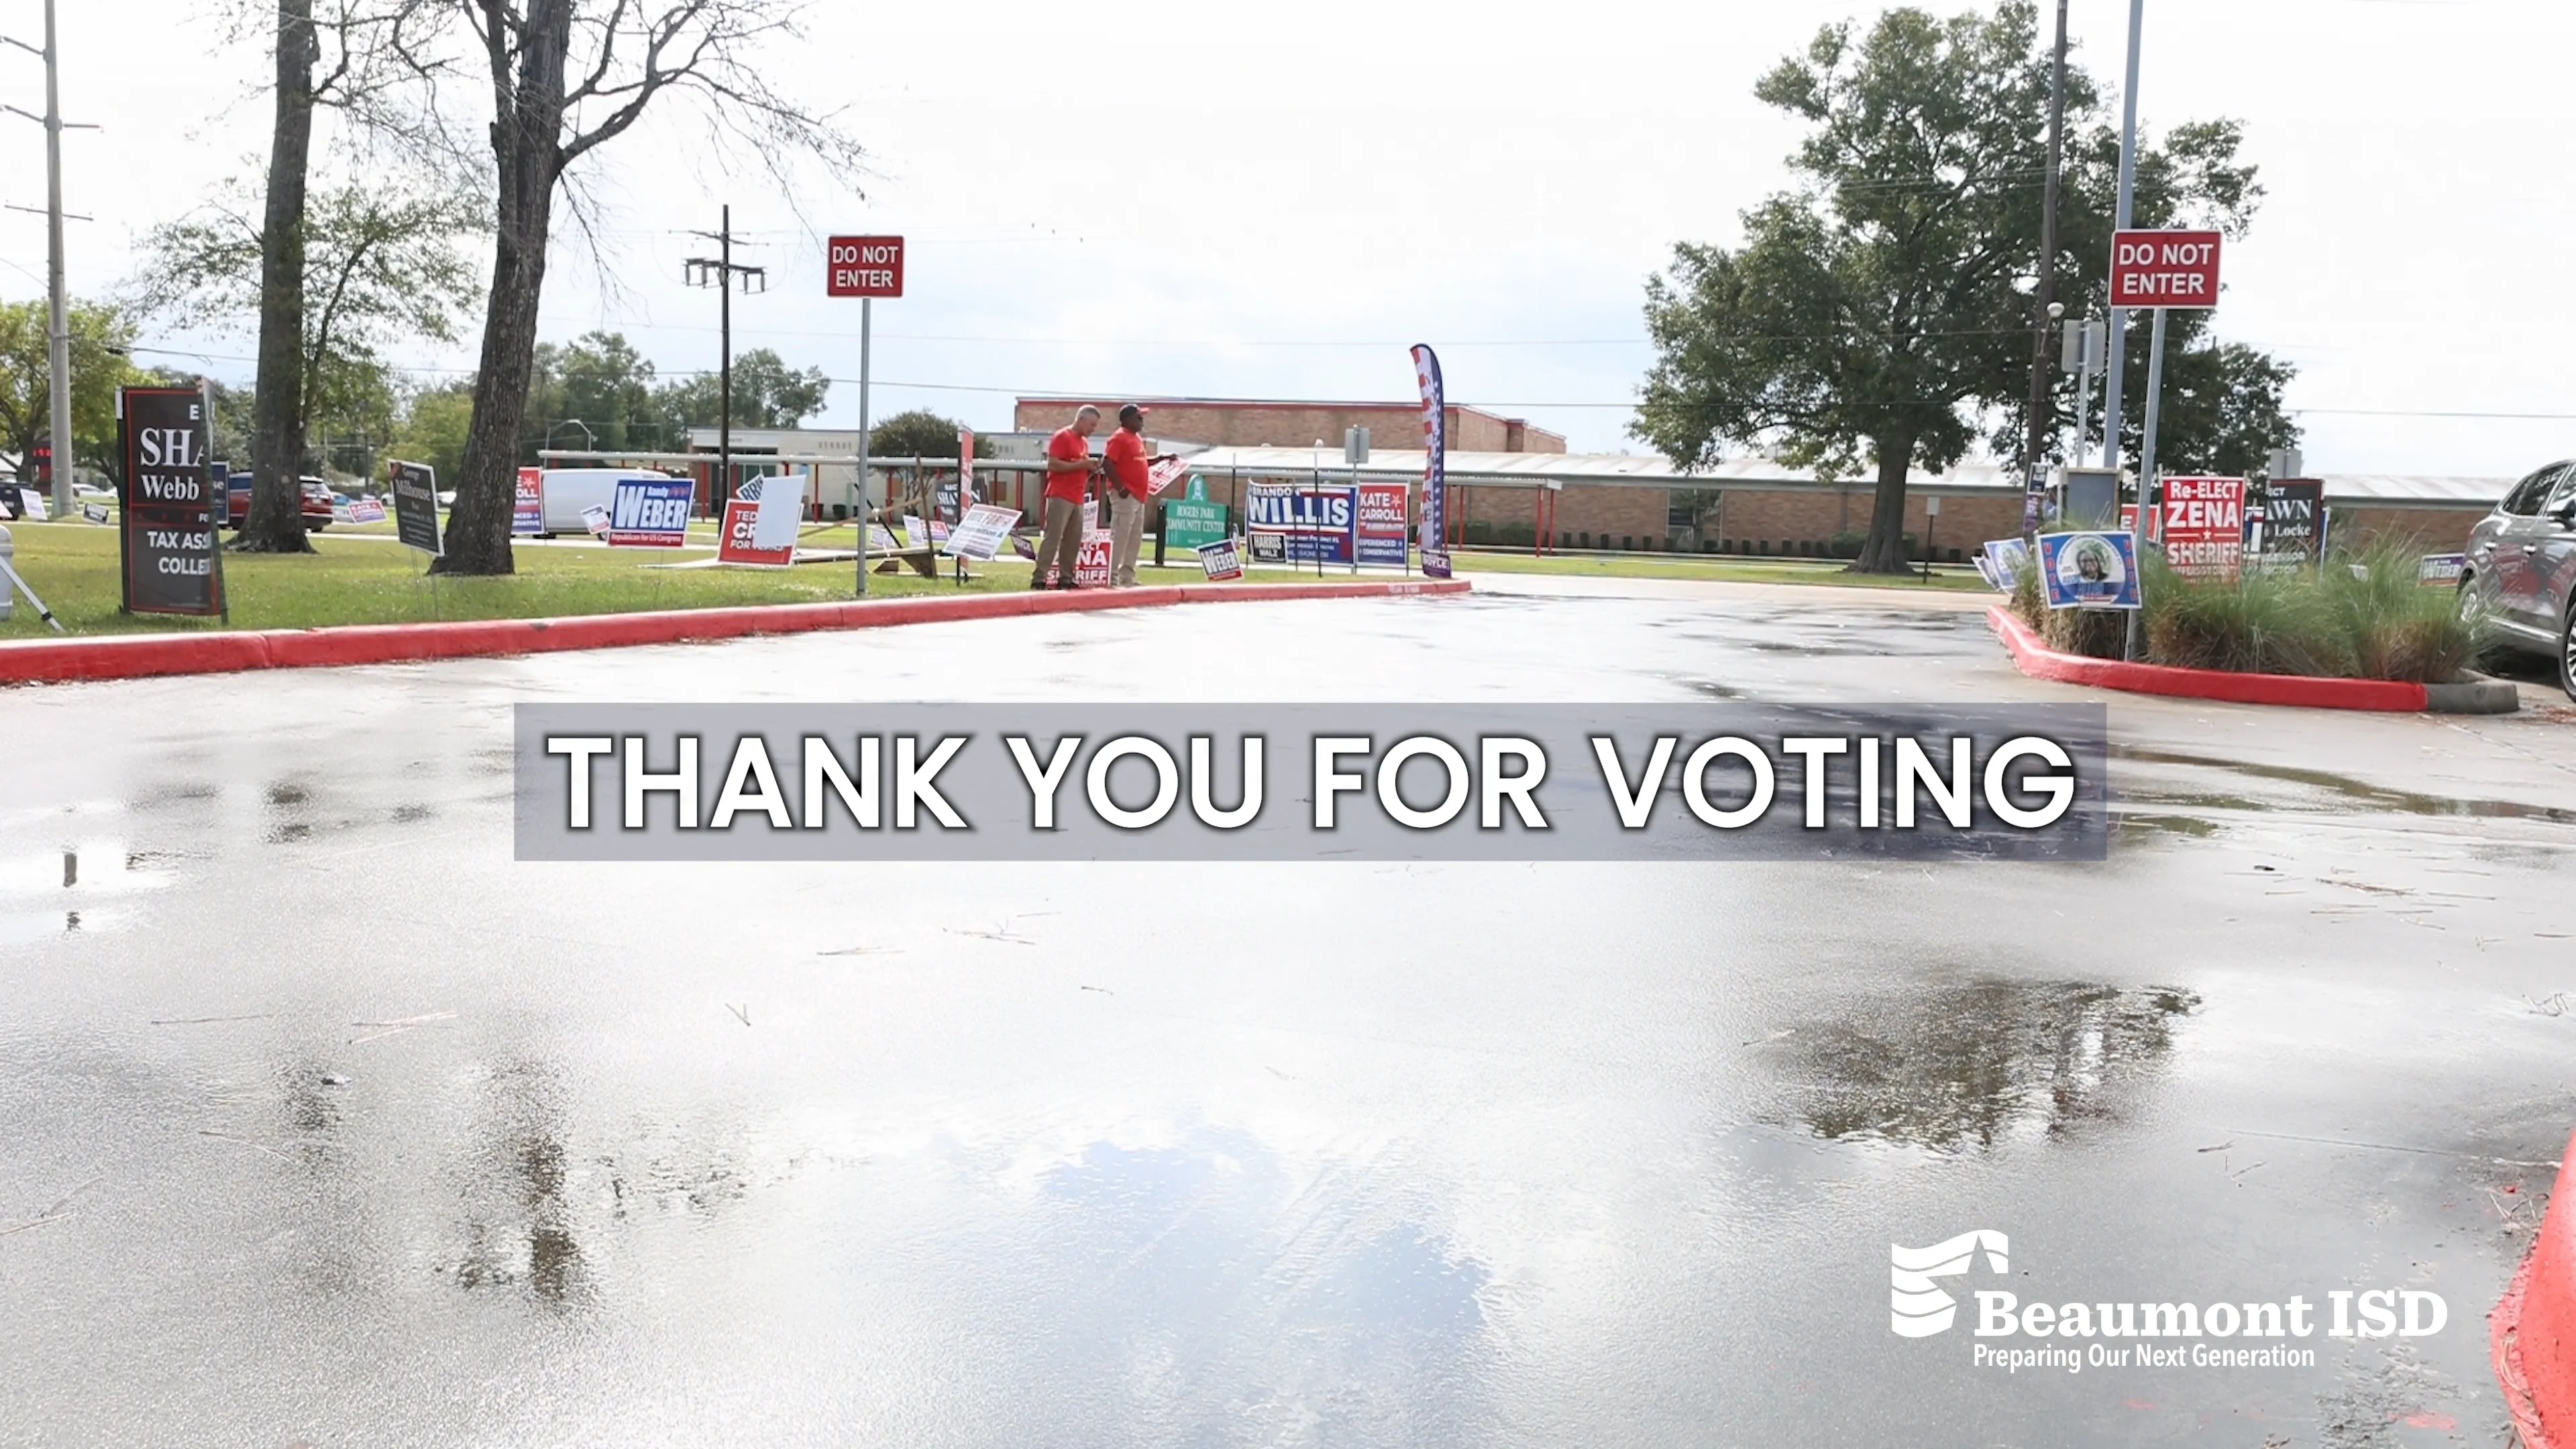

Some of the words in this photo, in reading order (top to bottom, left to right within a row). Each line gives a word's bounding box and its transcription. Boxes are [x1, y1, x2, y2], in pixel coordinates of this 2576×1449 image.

[833, 246, 857, 264] DO
[862, 246, 899, 264] NOT
[2118, 244, 2155, 266] DO
[2161, 244, 2214, 266] NOT
[836, 270, 894, 287] ENTER
[2123, 273, 2205, 295] ENTER
[140, 474, 200, 500] Webb
[2170, 482, 2239, 499] Re-ELECT
[937, 489, 980, 505] SHAN
[1360, 492, 1390, 507] KATE
[615, 485, 687, 529] WEBER
[1177, 505, 1197, 518] ROGERS
[1200, 508, 1216, 519] PARK
[1248, 495, 1349, 526] WILLIS
[1360, 508, 1403, 521] CARROLL
[2167, 501, 2239, 528] ZENA
[735, 510, 758, 522] TED
[1203, 521, 1226, 533] CENTER
[2275, 523, 2312, 537] Locke
[147, 531, 179, 549] TAX
[730, 539, 751, 549] FOR
[1253, 535, 1282, 550] HARRIS
[1358, 538, 1396, 547] EXPERIENCED
[1258, 549, 1278, 557] WALZ
[1362, 549, 1403, 557] CONSERVATIVE
[2167, 542, 2239, 564] SHERIFF
[1201, 550, 1239, 574] WEBER
